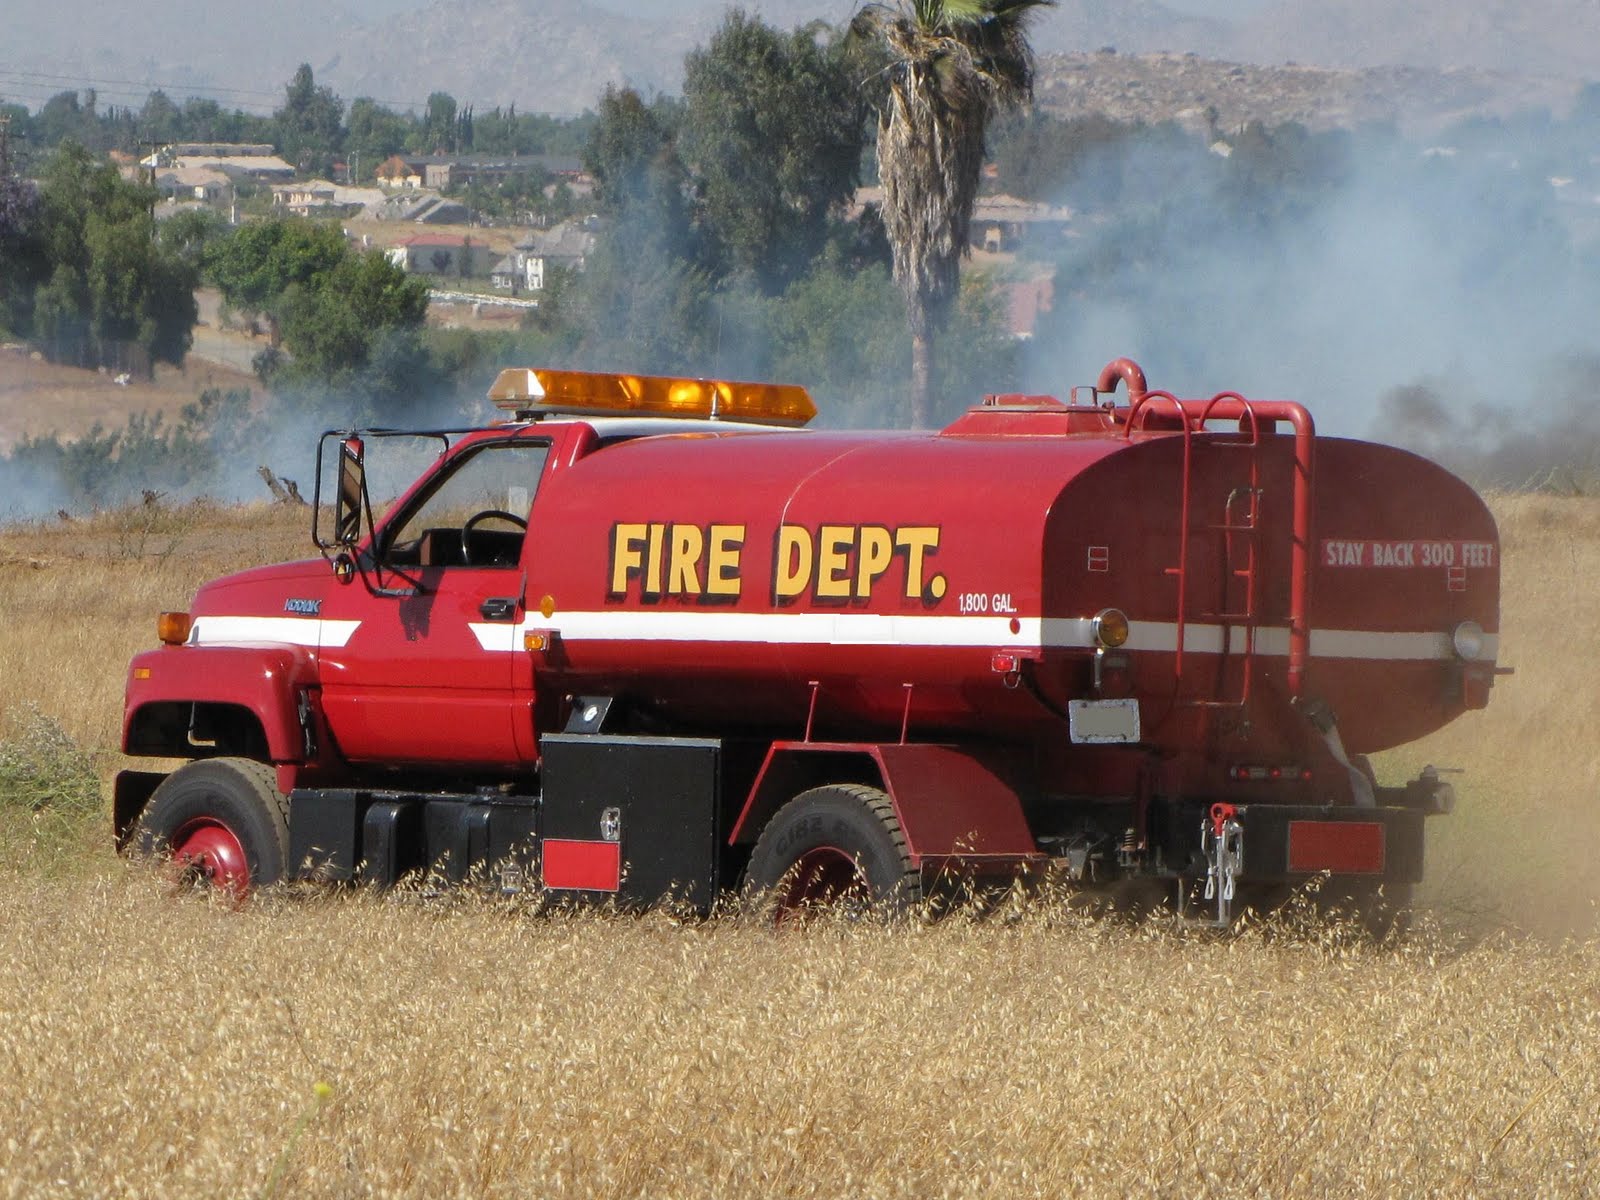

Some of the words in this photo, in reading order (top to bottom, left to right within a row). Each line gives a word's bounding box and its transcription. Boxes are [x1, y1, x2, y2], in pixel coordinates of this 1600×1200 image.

[608, 523, 746, 601] FIRE
[773, 525, 946, 602] DEPT.
[1326, 542, 1364, 566] STAY
[1373, 543, 1414, 567] BACK
[1421, 543, 1455, 566] 300
[1462, 543, 1493, 567] FEET
[959, 593, 988, 615] 1,800
[992, 593, 1017, 612] GAL.
